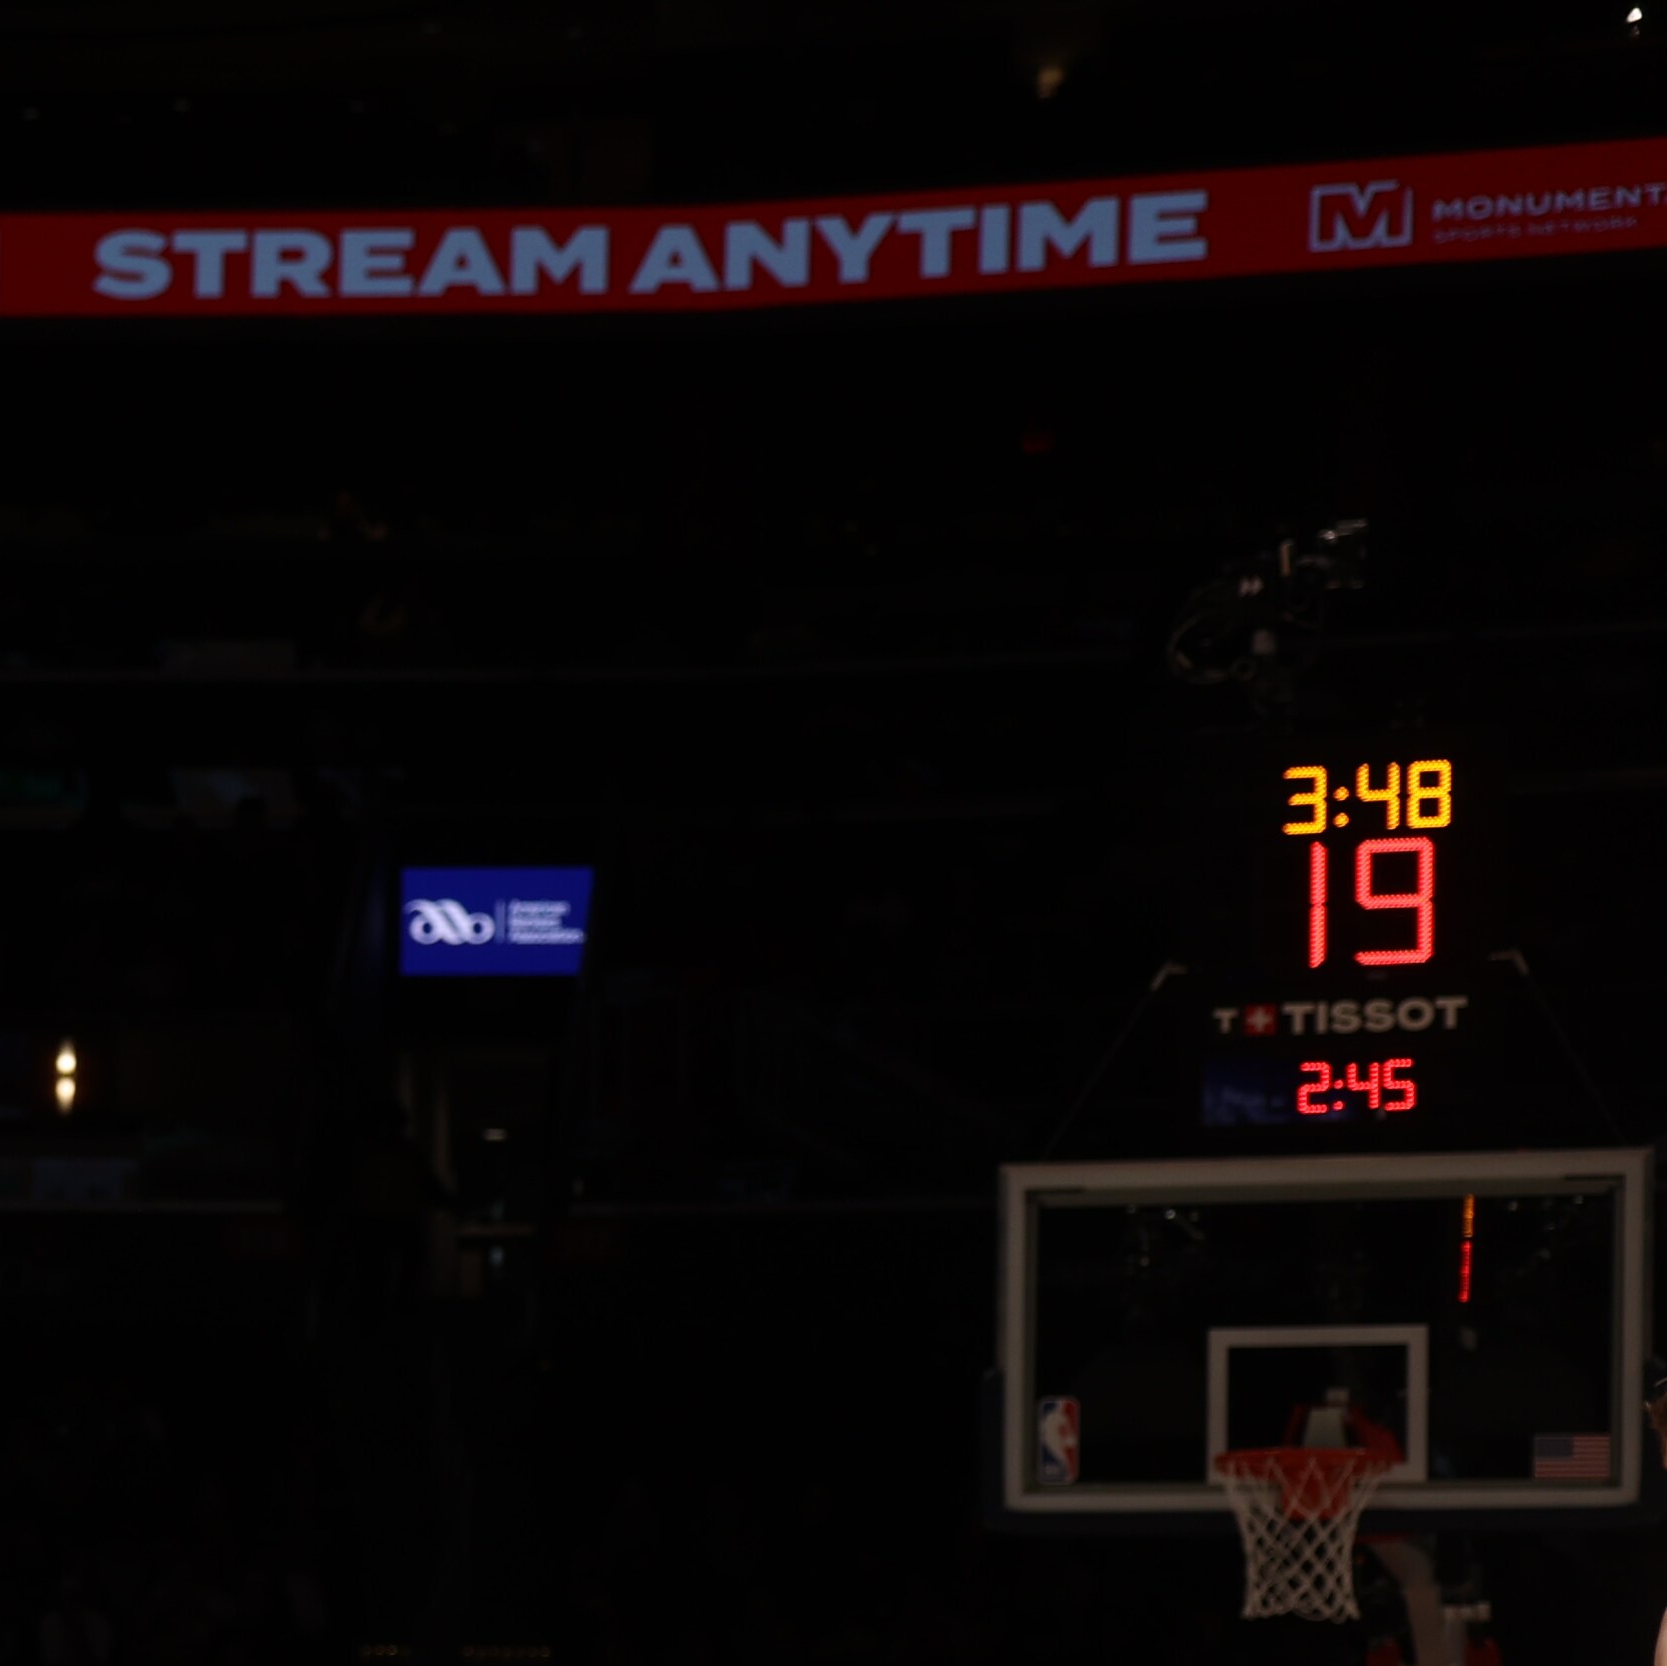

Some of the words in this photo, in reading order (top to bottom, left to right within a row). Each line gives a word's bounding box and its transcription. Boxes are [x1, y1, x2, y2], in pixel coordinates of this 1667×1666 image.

[1430, 182, 1667, 223] MONUMENT
[90, 221, 610, 302] STREAM
[627, 188, 1209, 297] ANYTIME
[1279, 757, 1455, 837] 3:48
[1306, 835, 1437, 970] 19
[1280, 994, 1470, 1037] TISSOT
[1294, 1056, 1419, 1117] 2:45
